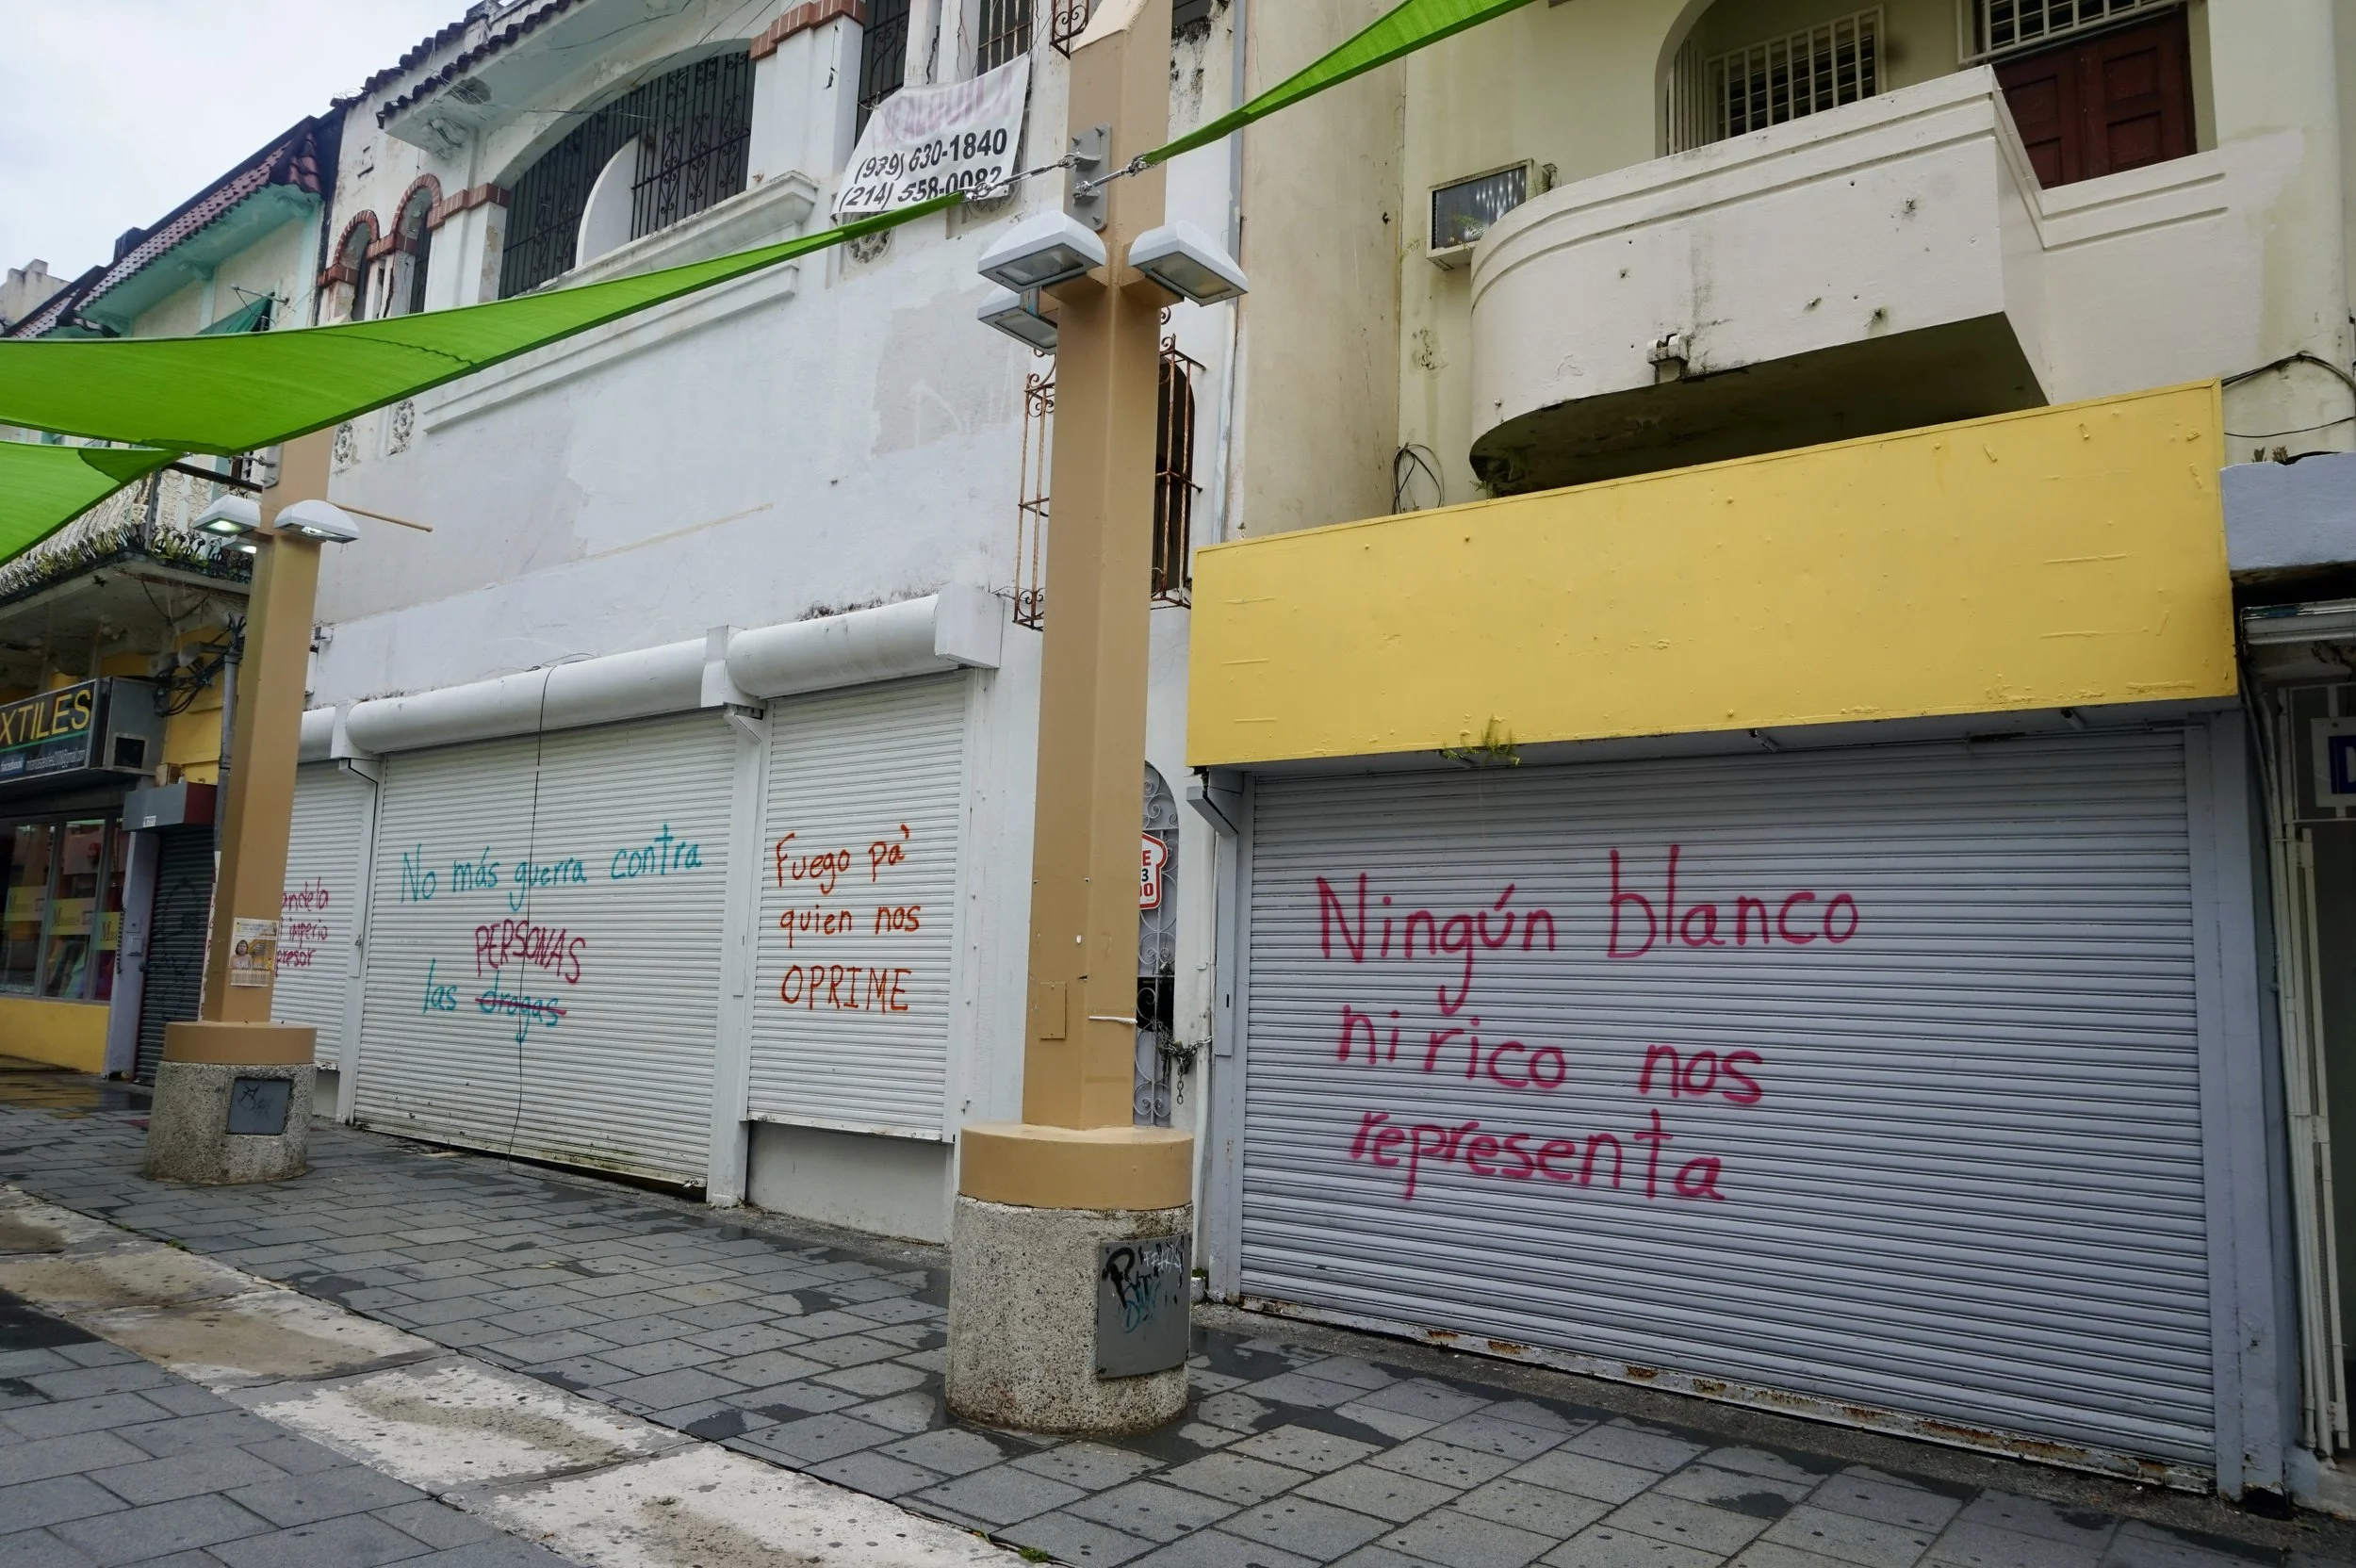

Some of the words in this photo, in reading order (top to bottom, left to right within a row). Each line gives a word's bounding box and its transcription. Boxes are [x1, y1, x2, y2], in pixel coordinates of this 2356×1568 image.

[854, 153, 906, 185] (939)
[908, 128, 1007, 172] 630-1840
[839, 182, 894, 212] (214)
[401, 843, 437, 904] No
[452, 845, 499, 893] más
[509, 856, 587, 912] guerra
[611, 823, 703, 880] contra
[474, 918, 587, 985] PERSONAS
[779, 904, 853, 949] quien
[875, 905, 922, 935] nos
[1317, 873, 1556, 1015] Ningún
[1608, 844, 1858, 958] blanco
[423, 957, 458, 1015] las
[780, 964, 912, 1015] OPRIME
[1337, 1004, 1400, 1065] ni
[1424, 1017, 1567, 1089] rico
[1638, 1044, 1764, 1103] nos
[1350, 1108, 1726, 1201] representa
